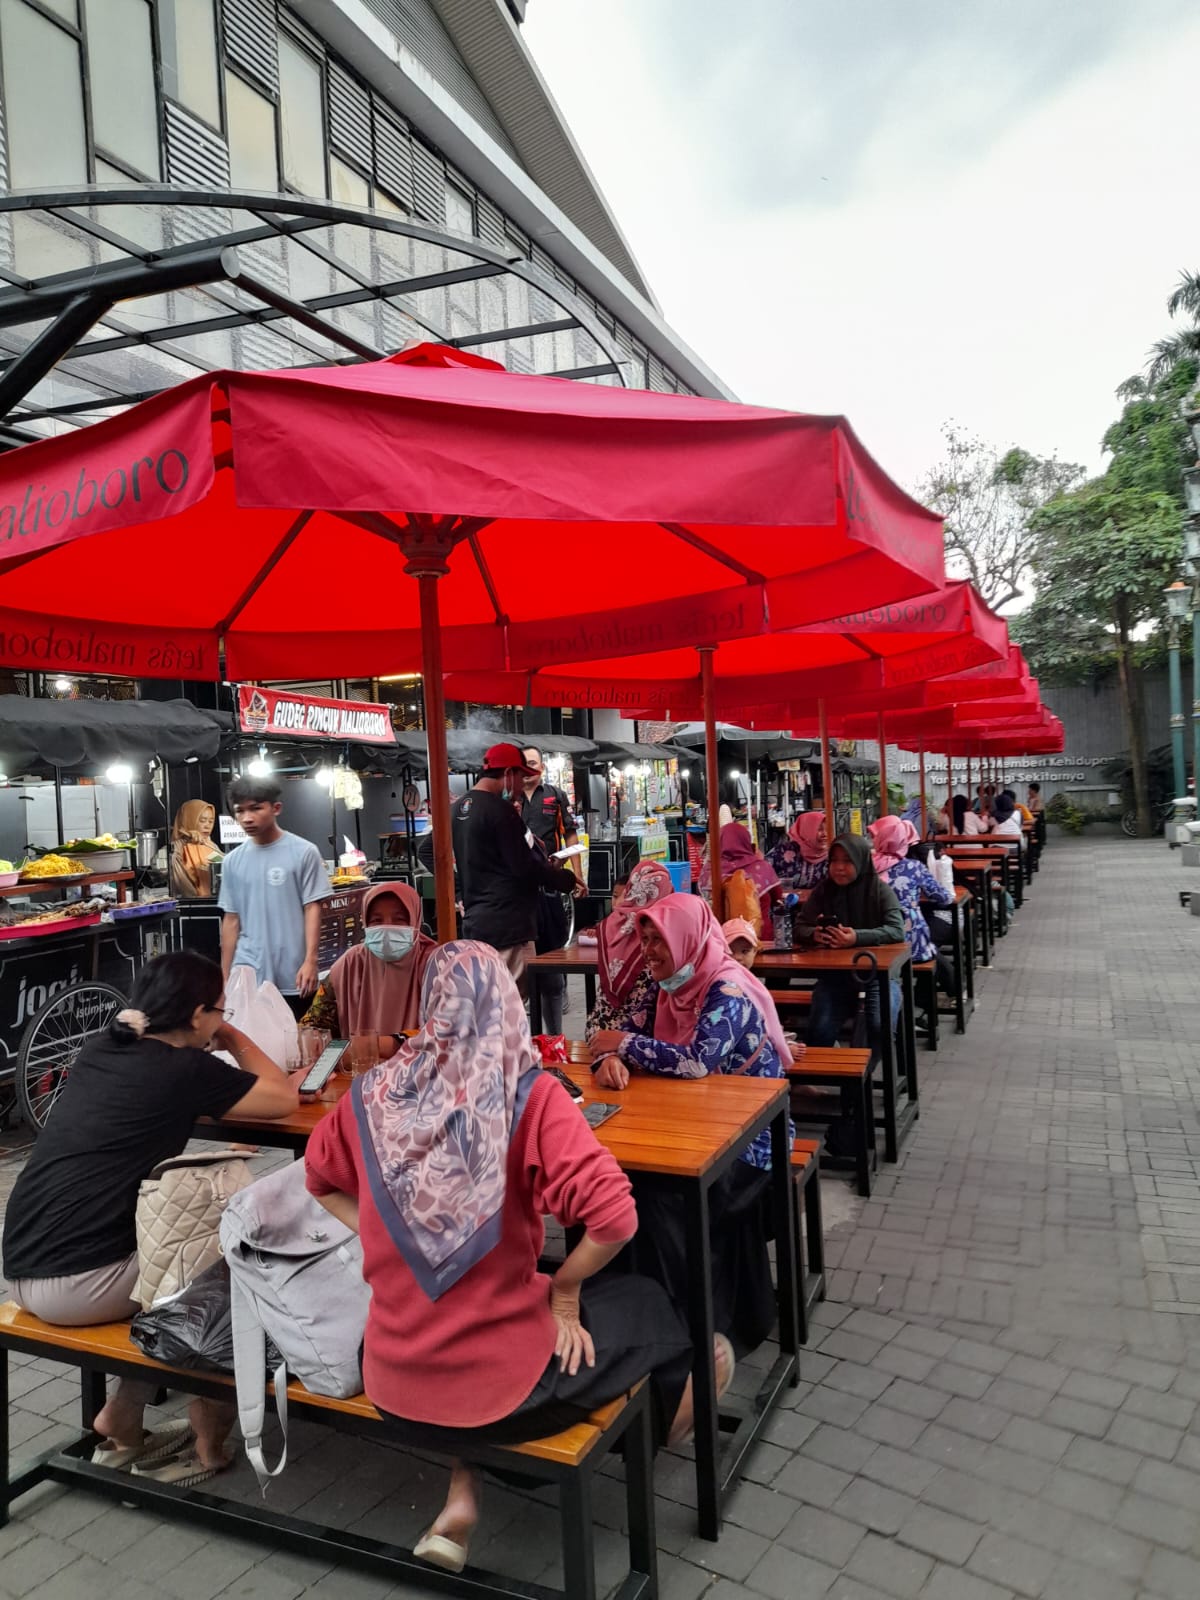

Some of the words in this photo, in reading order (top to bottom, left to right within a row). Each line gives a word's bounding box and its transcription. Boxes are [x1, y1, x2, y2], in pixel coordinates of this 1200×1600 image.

[273, 701, 305, 729] GUDEG
[340, 709, 387, 737] MALIOBORO
[900, 761, 932, 774] Hidp
[1017, 771, 1085, 782] Sekitarnya
[330, 897, 350, 909] MENU
